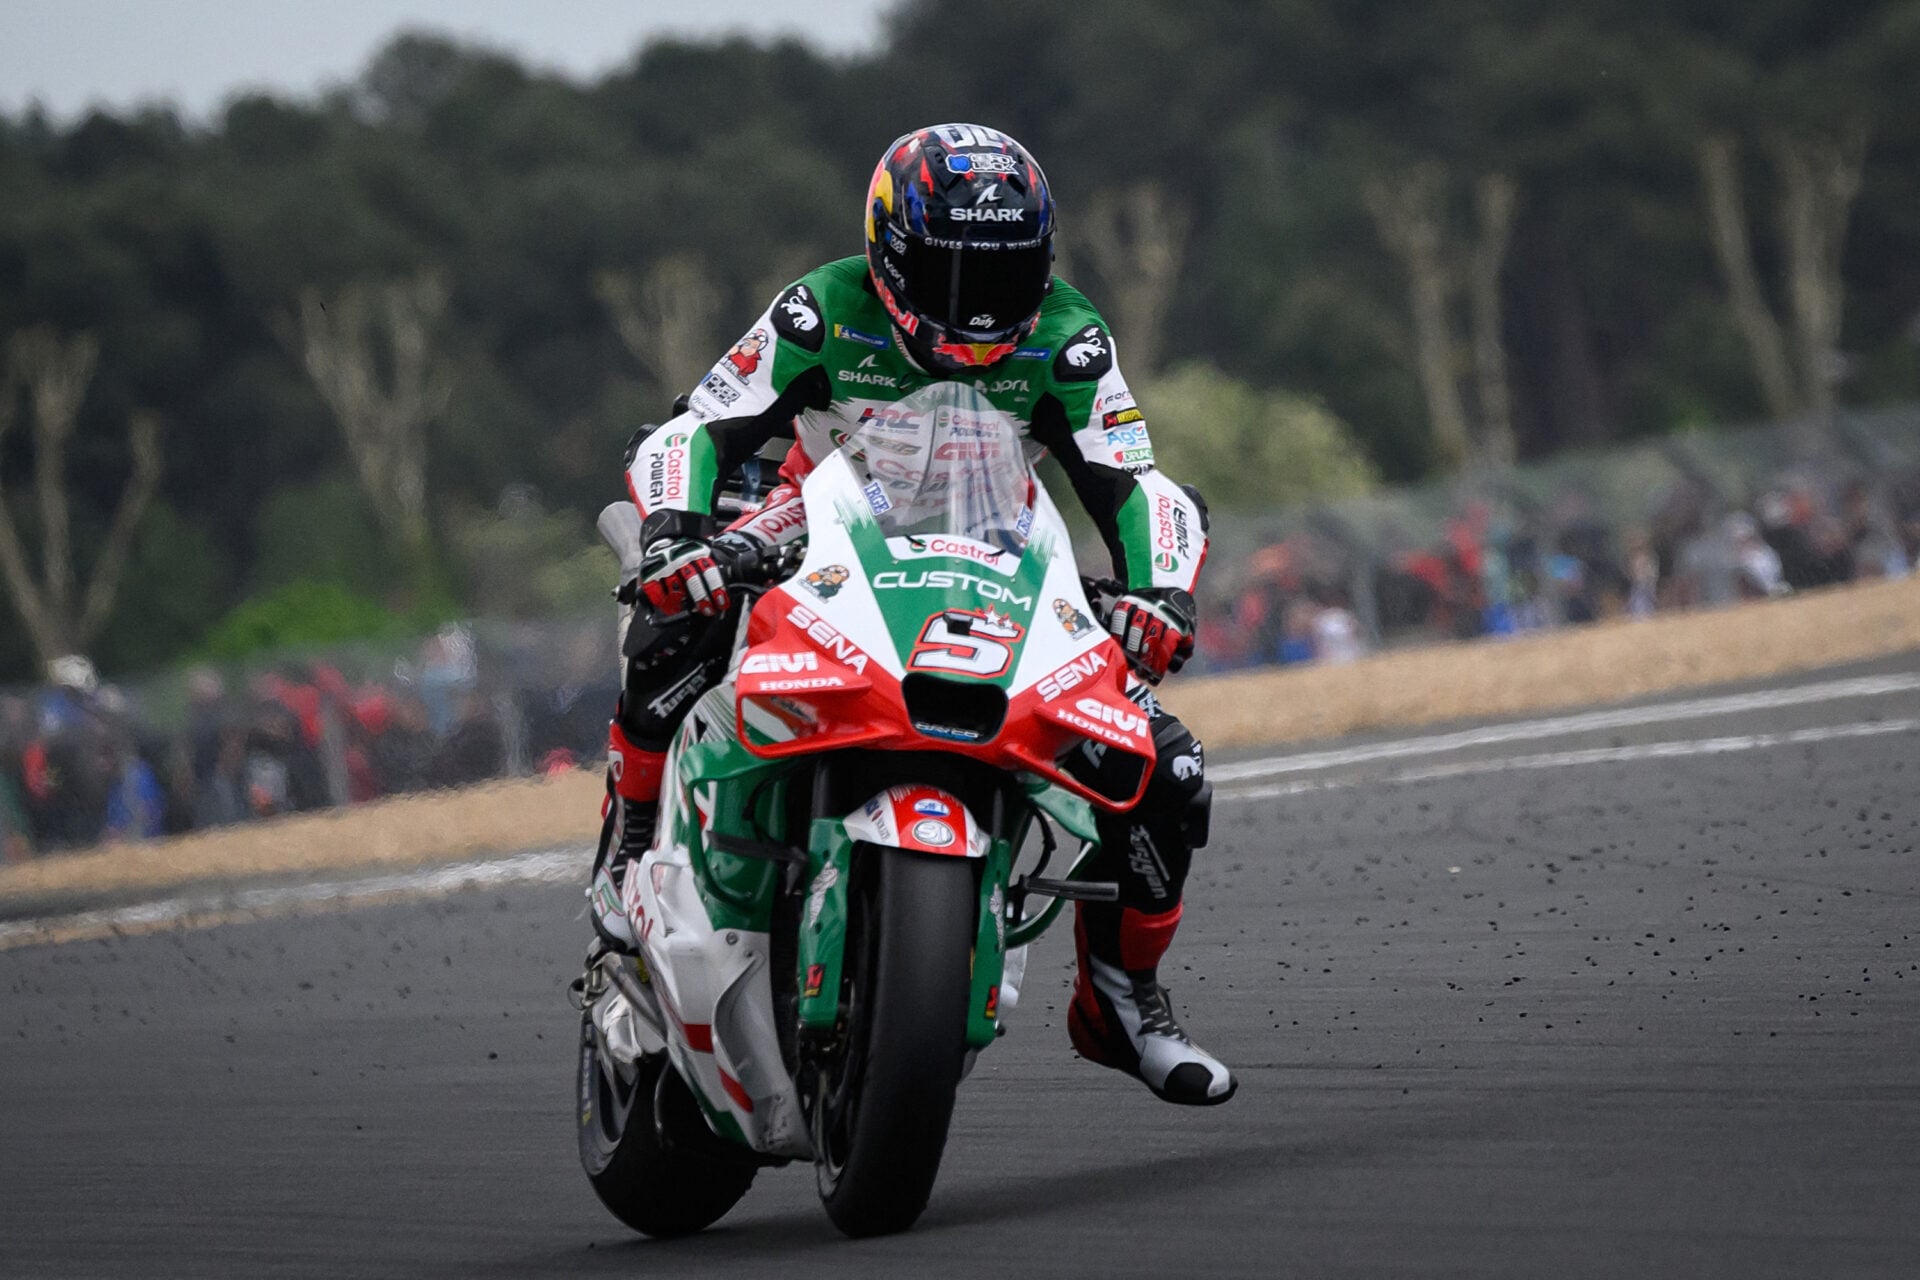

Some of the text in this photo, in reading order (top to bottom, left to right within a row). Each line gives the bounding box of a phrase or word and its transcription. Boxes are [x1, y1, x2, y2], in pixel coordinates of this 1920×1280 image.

[950, 207, 1025, 222] SHARK
[924, 237, 963, 250] GIVES
[971, 241, 1001, 251] YOU
[968, 315, 996, 329] Dafy
[838, 369, 897, 388] SHARK
[667, 448, 685, 501] Castrol
[1155, 492, 1175, 551] Castrol
[930, 538, 1000, 566] Castrol
[872, 570, 1033, 612] CUSTOM
[786, 603, 869, 676] SENA
[906, 606, 1026, 679] 5
[740, 651, 819, 675] GIVI
[1036, 650, 1108, 703] SENA
[758, 676, 845, 692] HONDA
[1056, 708, 1136, 749] HONDA
[1075, 697, 1148, 738] GIVI
